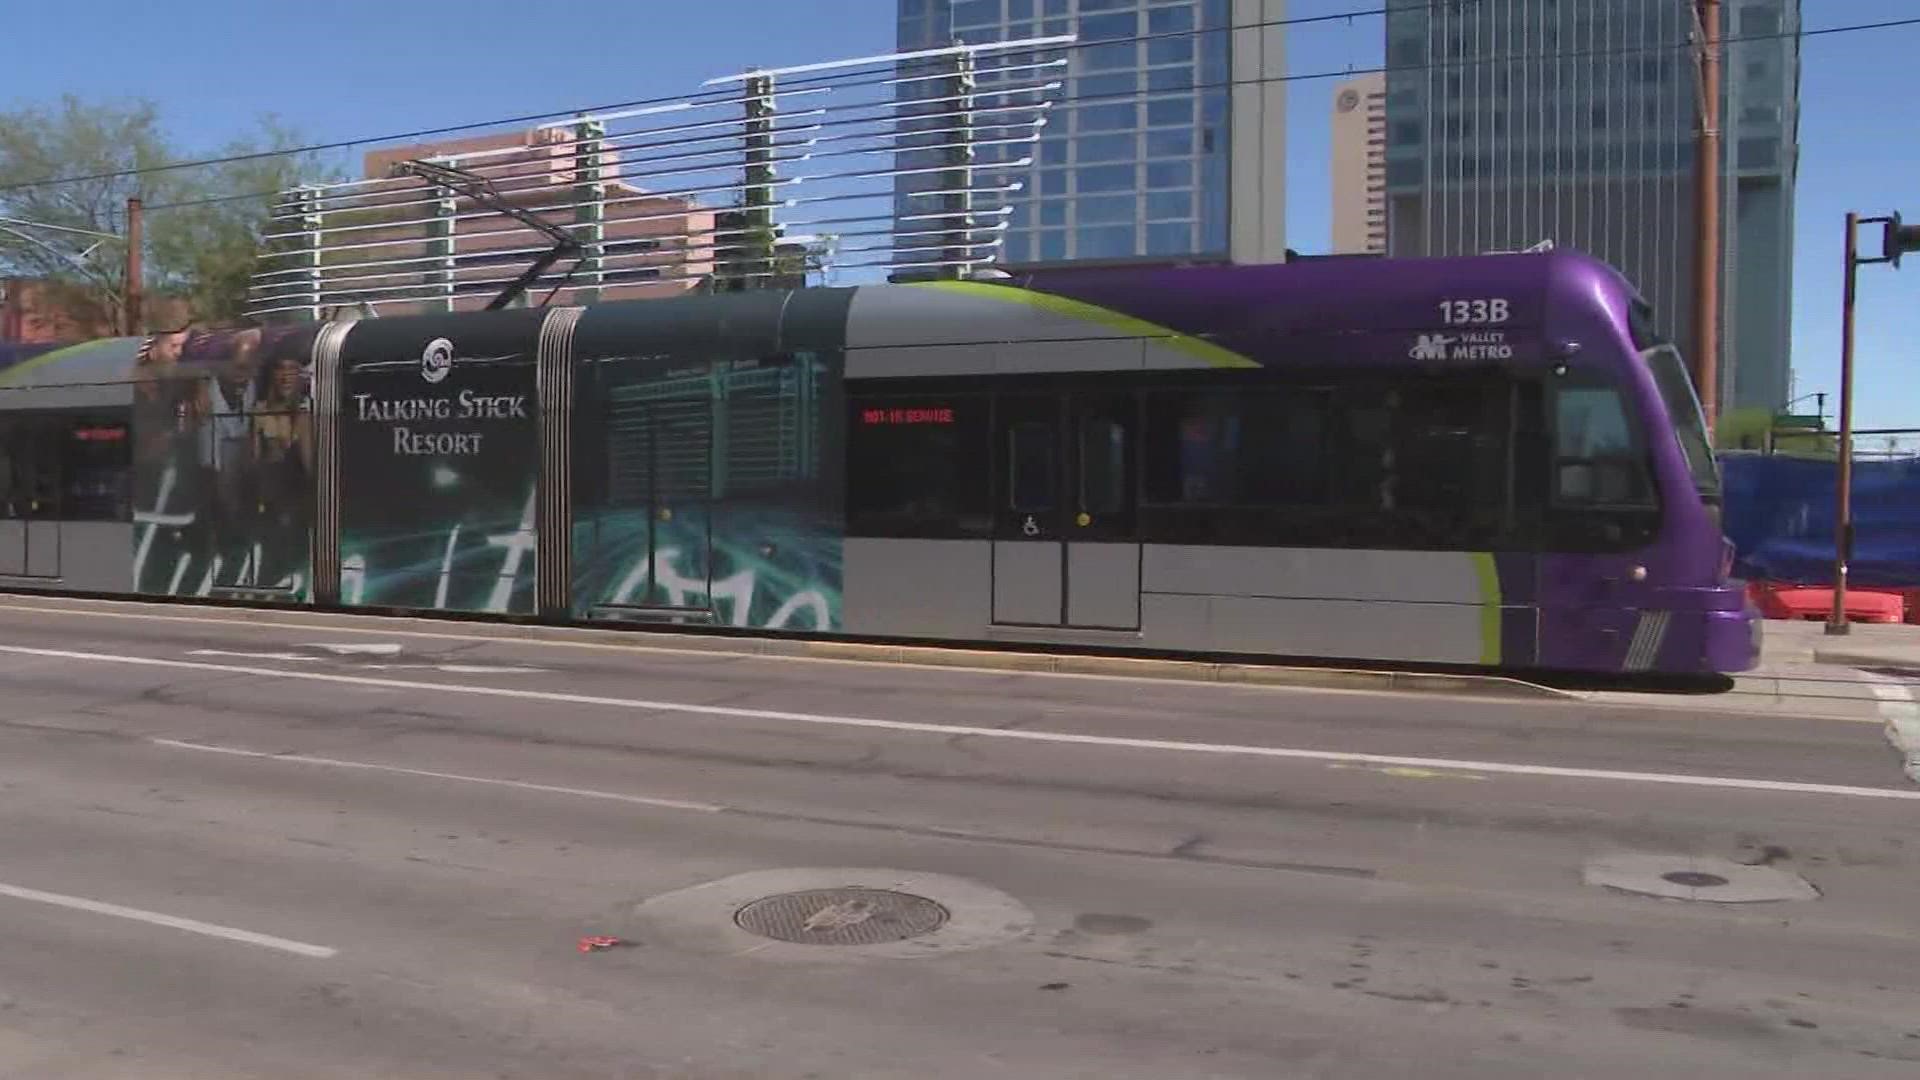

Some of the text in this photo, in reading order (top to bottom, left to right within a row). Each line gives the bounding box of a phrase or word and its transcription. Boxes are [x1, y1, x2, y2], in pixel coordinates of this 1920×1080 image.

[1439, 298, 1509, 324] 133B
[1461, 332, 1505, 344] VALLEY
[1453, 344, 1513, 360] METRO
[352, 389, 526, 421] TALKING STICK
[393, 426, 484, 455] RESORT
